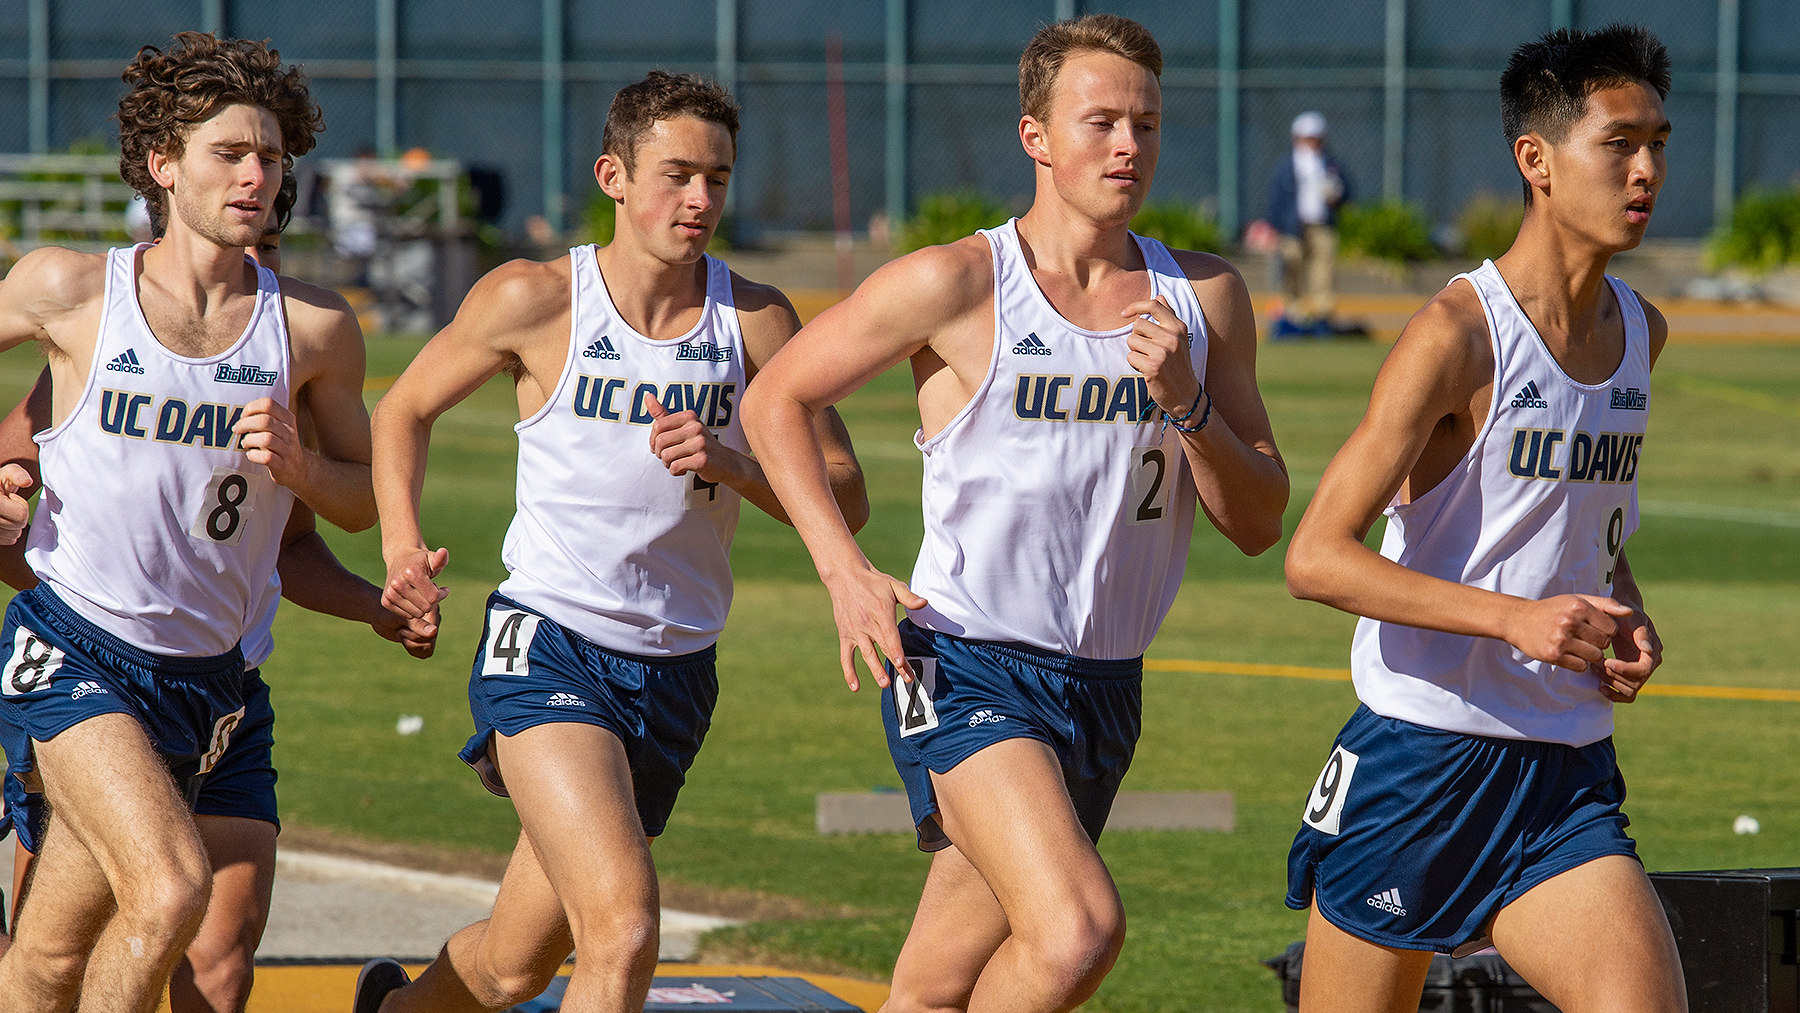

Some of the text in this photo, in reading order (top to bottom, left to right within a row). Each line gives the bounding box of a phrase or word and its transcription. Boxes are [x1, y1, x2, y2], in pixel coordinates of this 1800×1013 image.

[106, 362, 145, 375] adidas
[582, 349, 621, 361] adidas
[1012, 345, 1052, 356] adidas
[99, 387, 248, 452] UC DAV
[572, 373, 737, 429] UC DAVIS
[1013, 373, 1164, 424] UC DAV
[1510, 398, 1548, 409] adidas
[1507, 427, 1645, 485] UC DAVIS
[206, 474, 248, 541] 8
[1136, 449, 1166, 521] 2
[1605, 507, 1623, 585] 9
[11, 635, 54, 693] 8
[493, 613, 529, 672] 4
[71, 688, 109, 701] adidas
[546, 699, 586, 707] adidas
[904, 659, 928, 731] 2
[1309, 751, 1343, 824] 9
[1366, 897, 1407, 917] adidas
